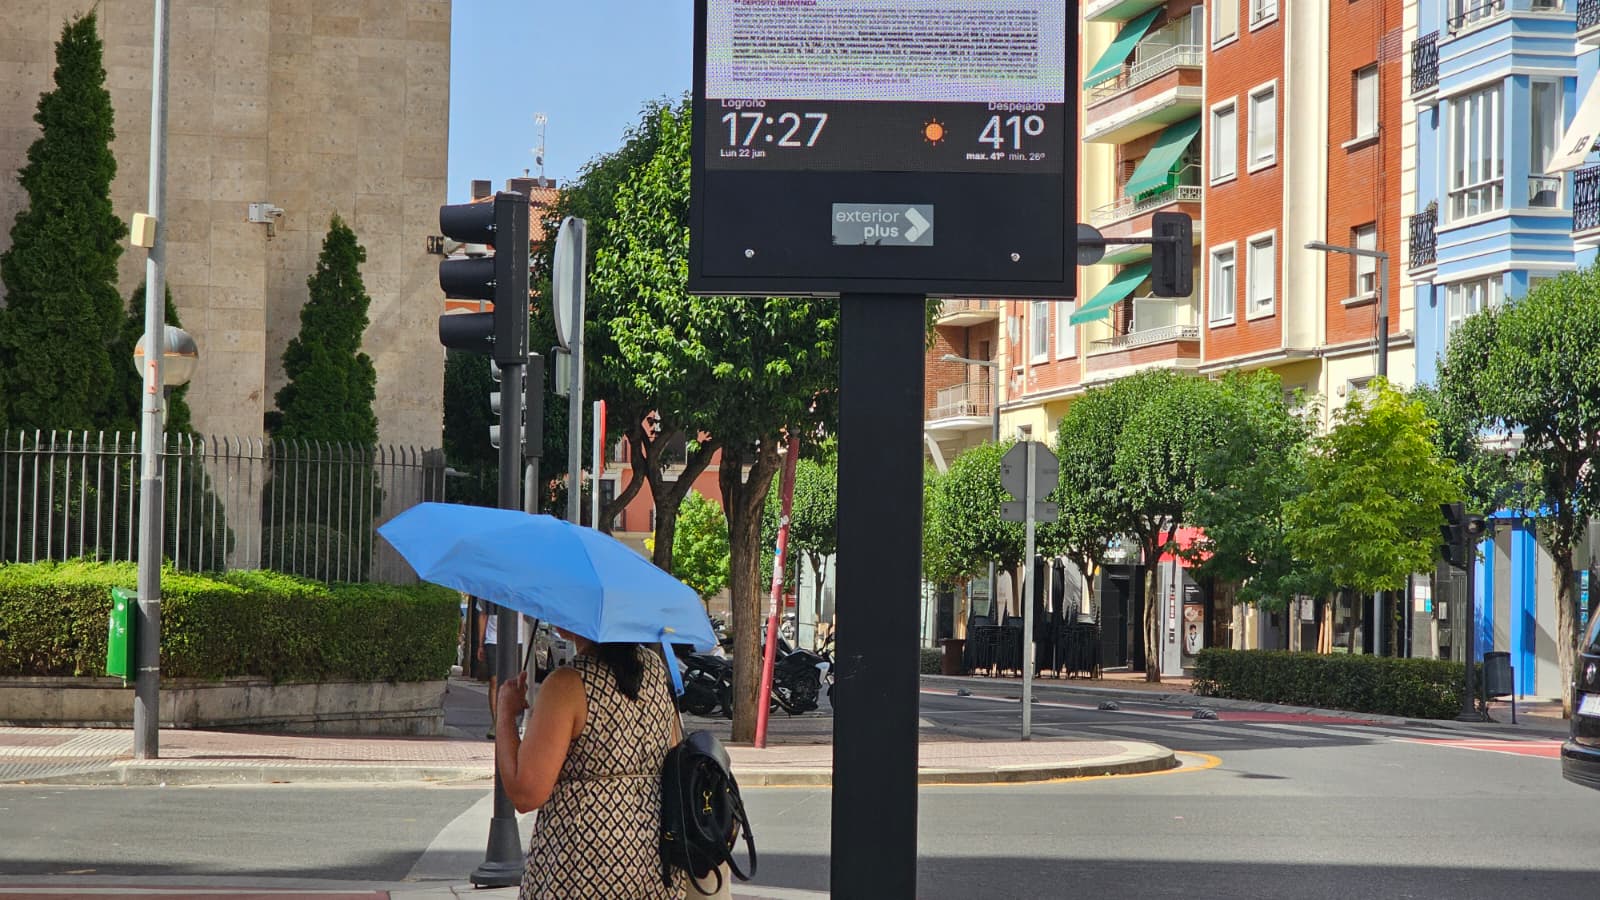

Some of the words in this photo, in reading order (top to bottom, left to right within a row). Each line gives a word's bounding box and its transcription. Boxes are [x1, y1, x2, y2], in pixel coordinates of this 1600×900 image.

[721, 98, 766, 109] Logroño
[988, 102, 1046, 113] Despejado
[721, 111, 828, 147] 17:27
[720, 149, 737, 157] Lun
[739, 149, 750, 157] 22
[751, 149, 766, 159] jun
[836, 209, 900, 223] exterior
[863, 224, 899, 240] plus
